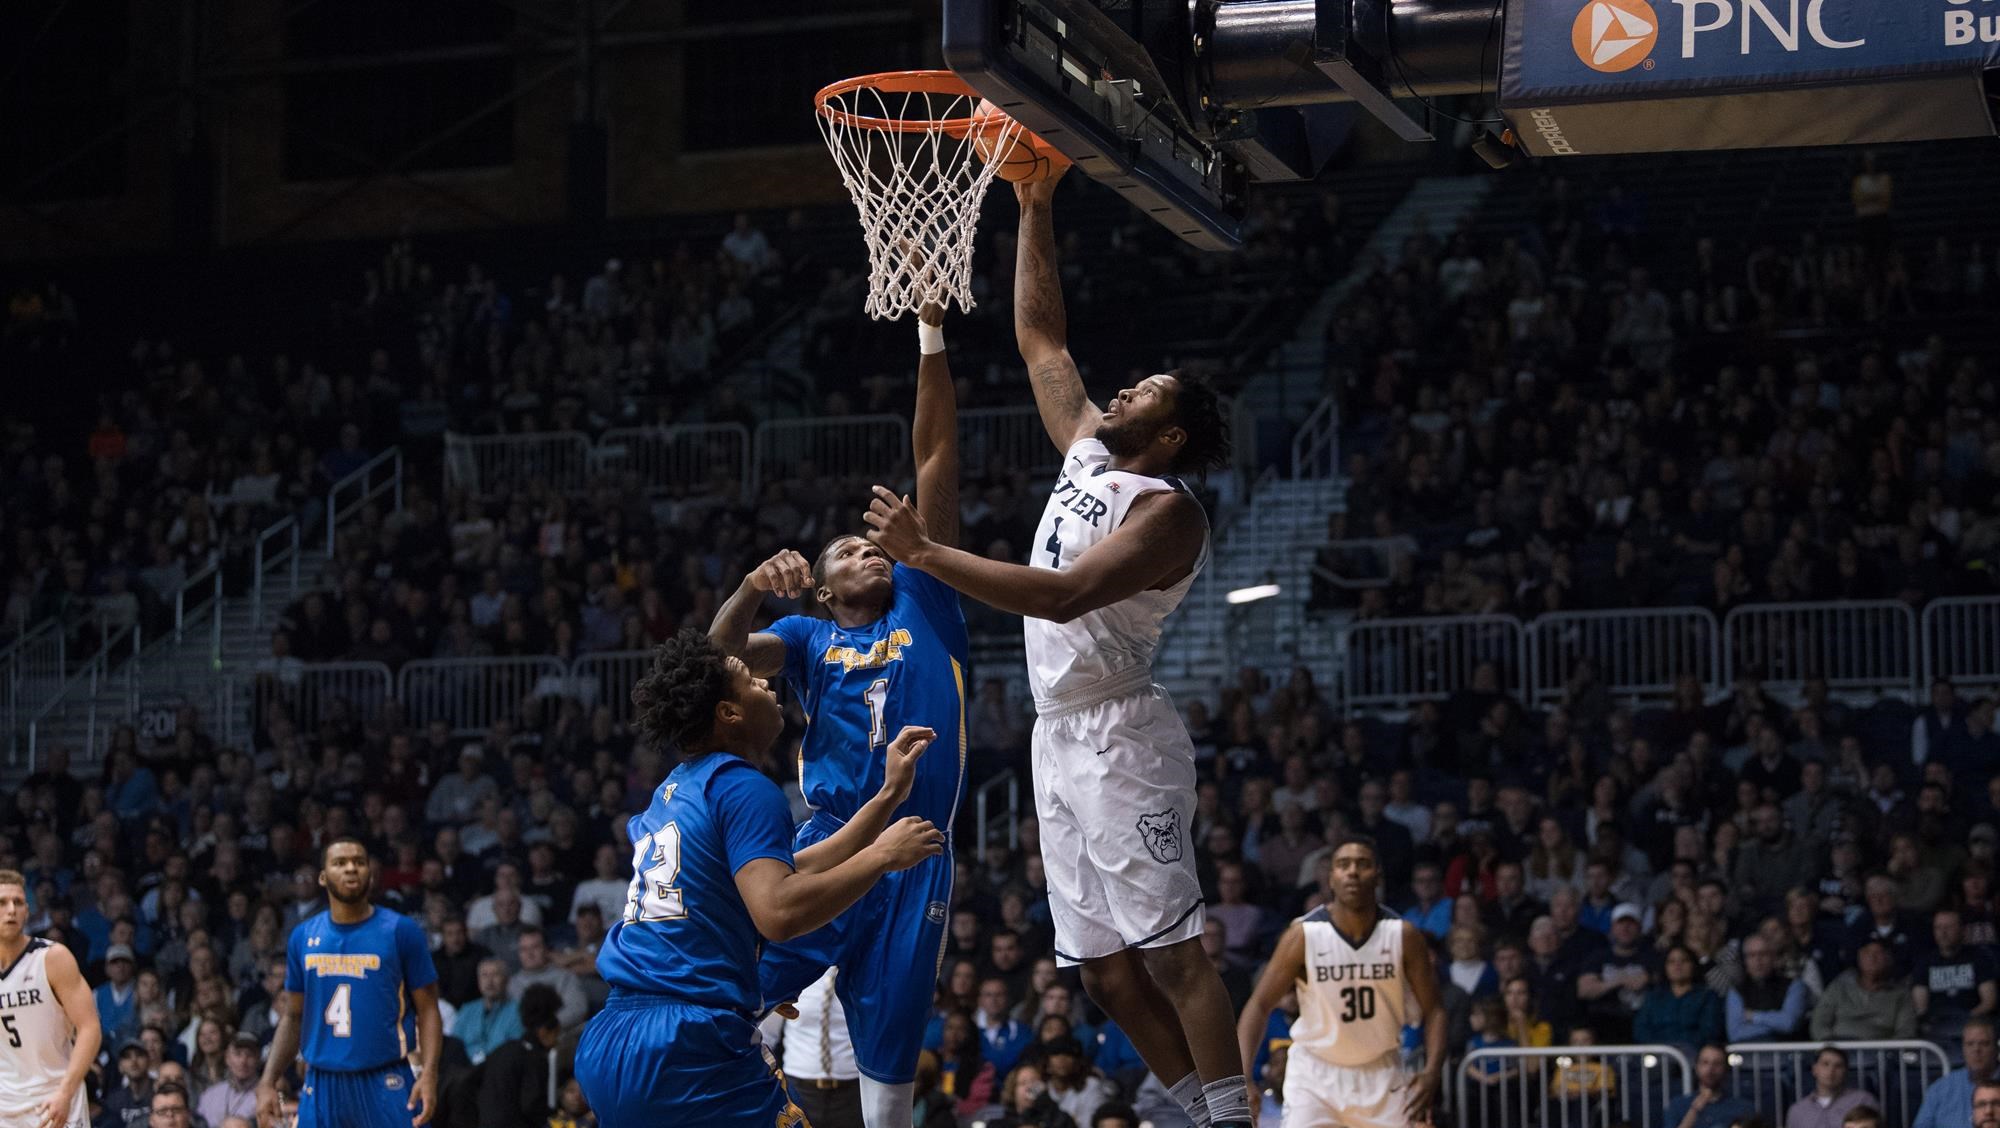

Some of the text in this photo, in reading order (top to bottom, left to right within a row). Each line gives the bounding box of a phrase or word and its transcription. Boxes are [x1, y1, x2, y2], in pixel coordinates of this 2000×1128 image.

[1670, 0, 1866, 59] PNC
[1944, 10, 2000, 46] Bu
[1046, 516, 1064, 569] 4
[864, 679, 889, 752] 1
[622, 821, 688, 928] 12
[1316, 963, 1395, 982] BUTLER
[325, 983, 352, 1038] 4
[1340, 986, 1375, 1023] 30
[1, 1015, 22, 1048] 5
